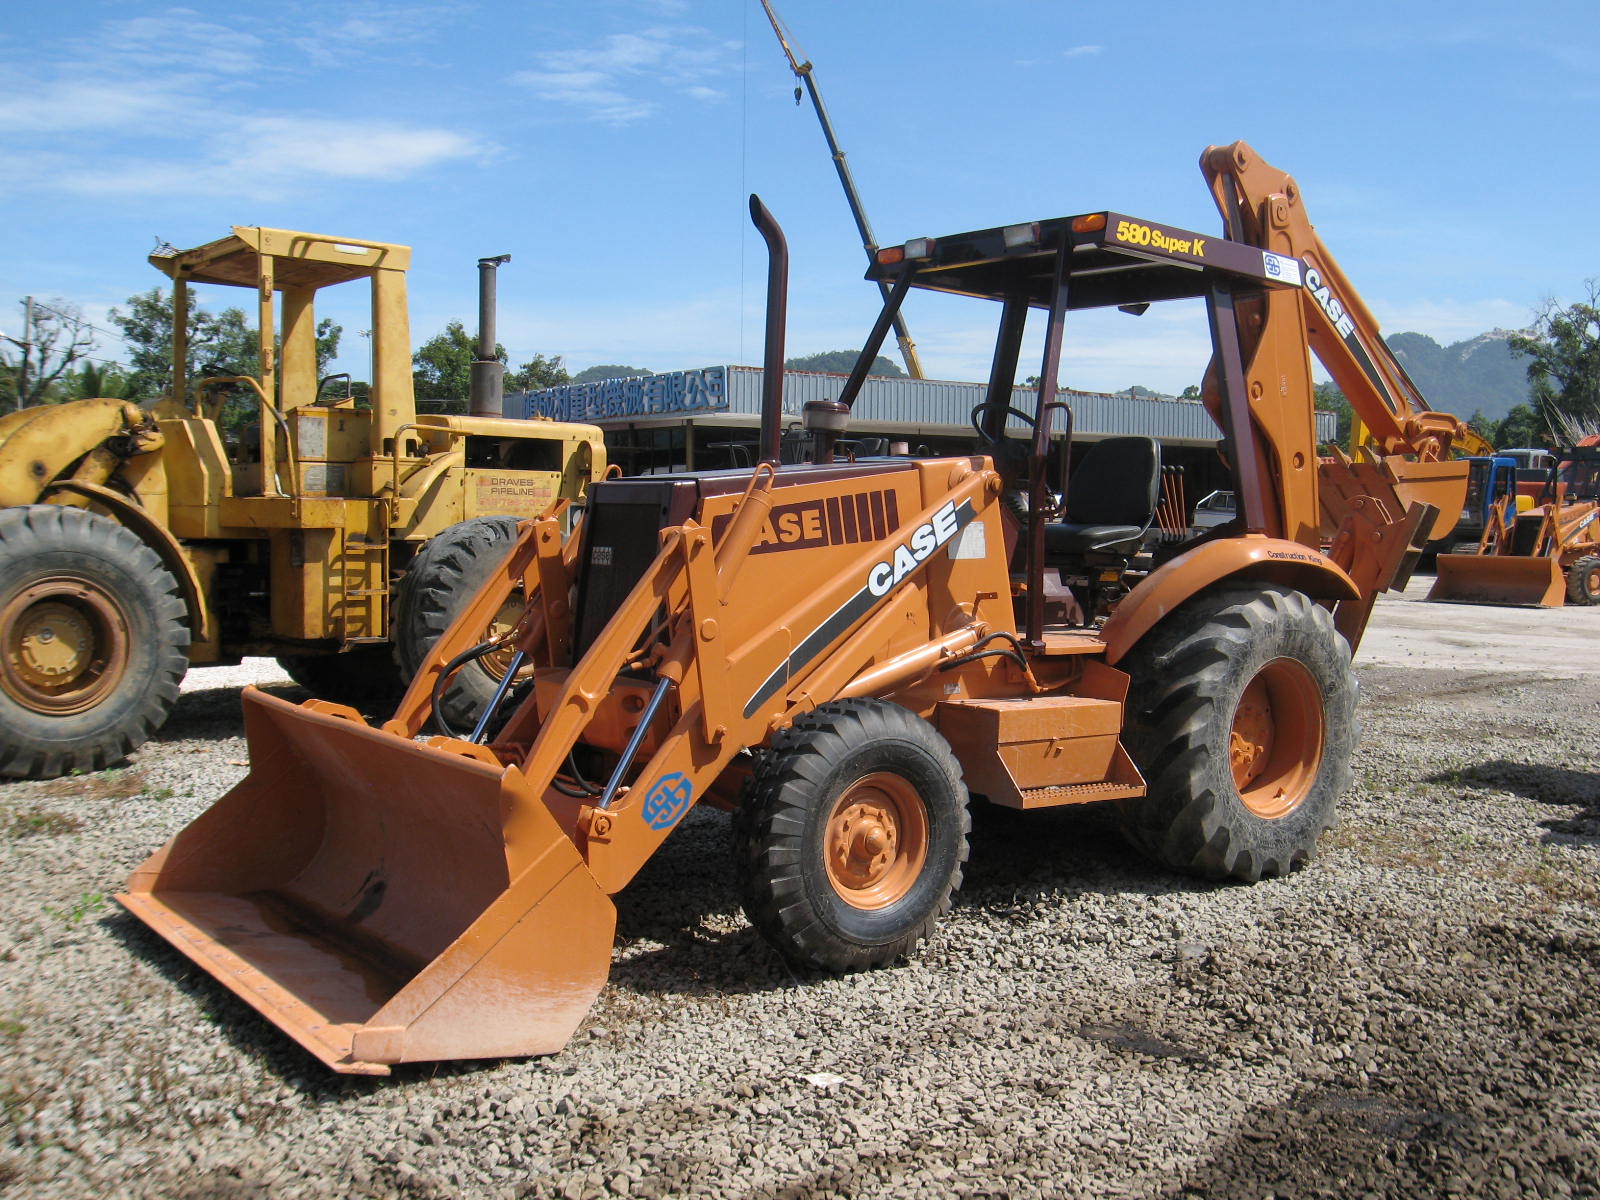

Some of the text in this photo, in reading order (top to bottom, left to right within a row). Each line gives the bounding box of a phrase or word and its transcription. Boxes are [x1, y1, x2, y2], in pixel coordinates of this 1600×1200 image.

[1116, 220, 1206, 257] 580 Super K
[1305, 268, 1355, 340] CASE
[491, 477, 534, 487] DRAVES
[491, 487, 534, 496] PIPELINE
[754, 508, 823, 548] ASE
[868, 499, 959, 597] CASE
[1267, 550, 1307, 561] Construction
